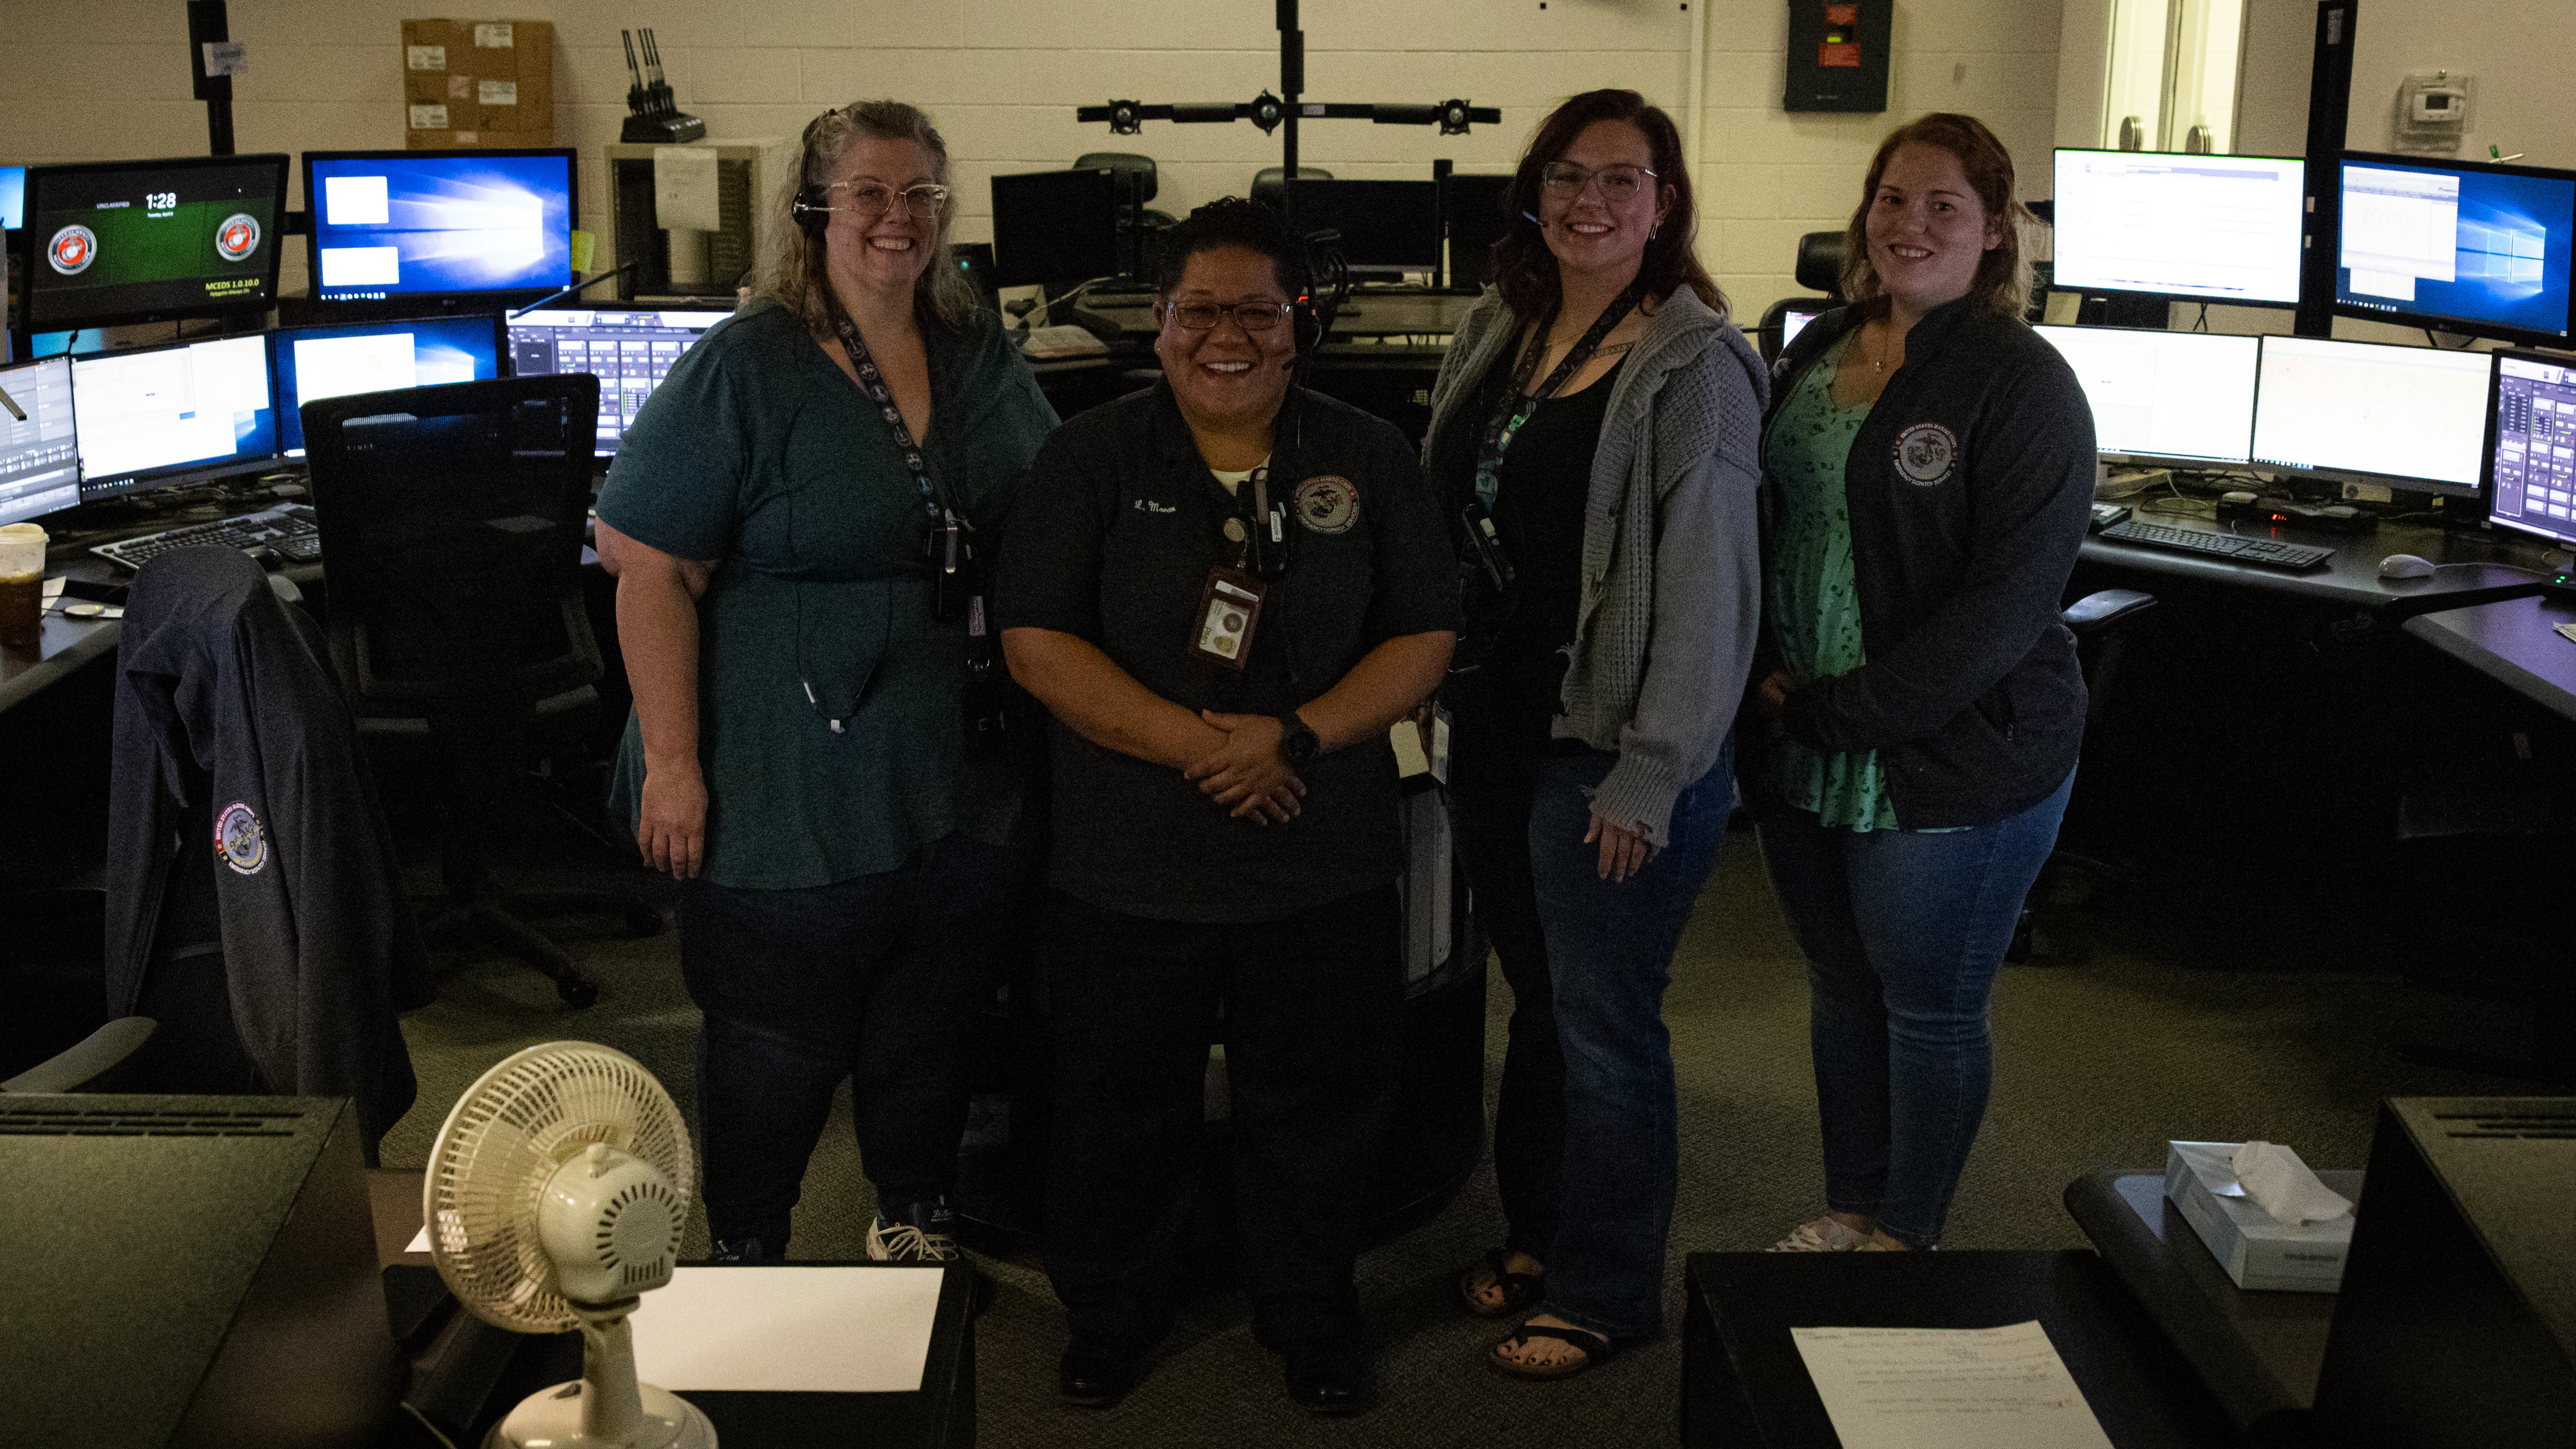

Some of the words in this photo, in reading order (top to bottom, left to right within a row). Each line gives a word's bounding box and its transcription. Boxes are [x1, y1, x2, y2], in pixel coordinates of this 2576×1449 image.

[146, 192, 176, 210] 1:28
[206, 281, 231, 291] MCEDS
[232, 278, 259, 289] 1.0.10.0
[1900, 426, 1915, 439] UNITED
[1934, 423, 1951, 436] MARINE
[1894, 459, 1912, 483] EMERGENCY
[1339, 479, 1352, 490] CORPS
